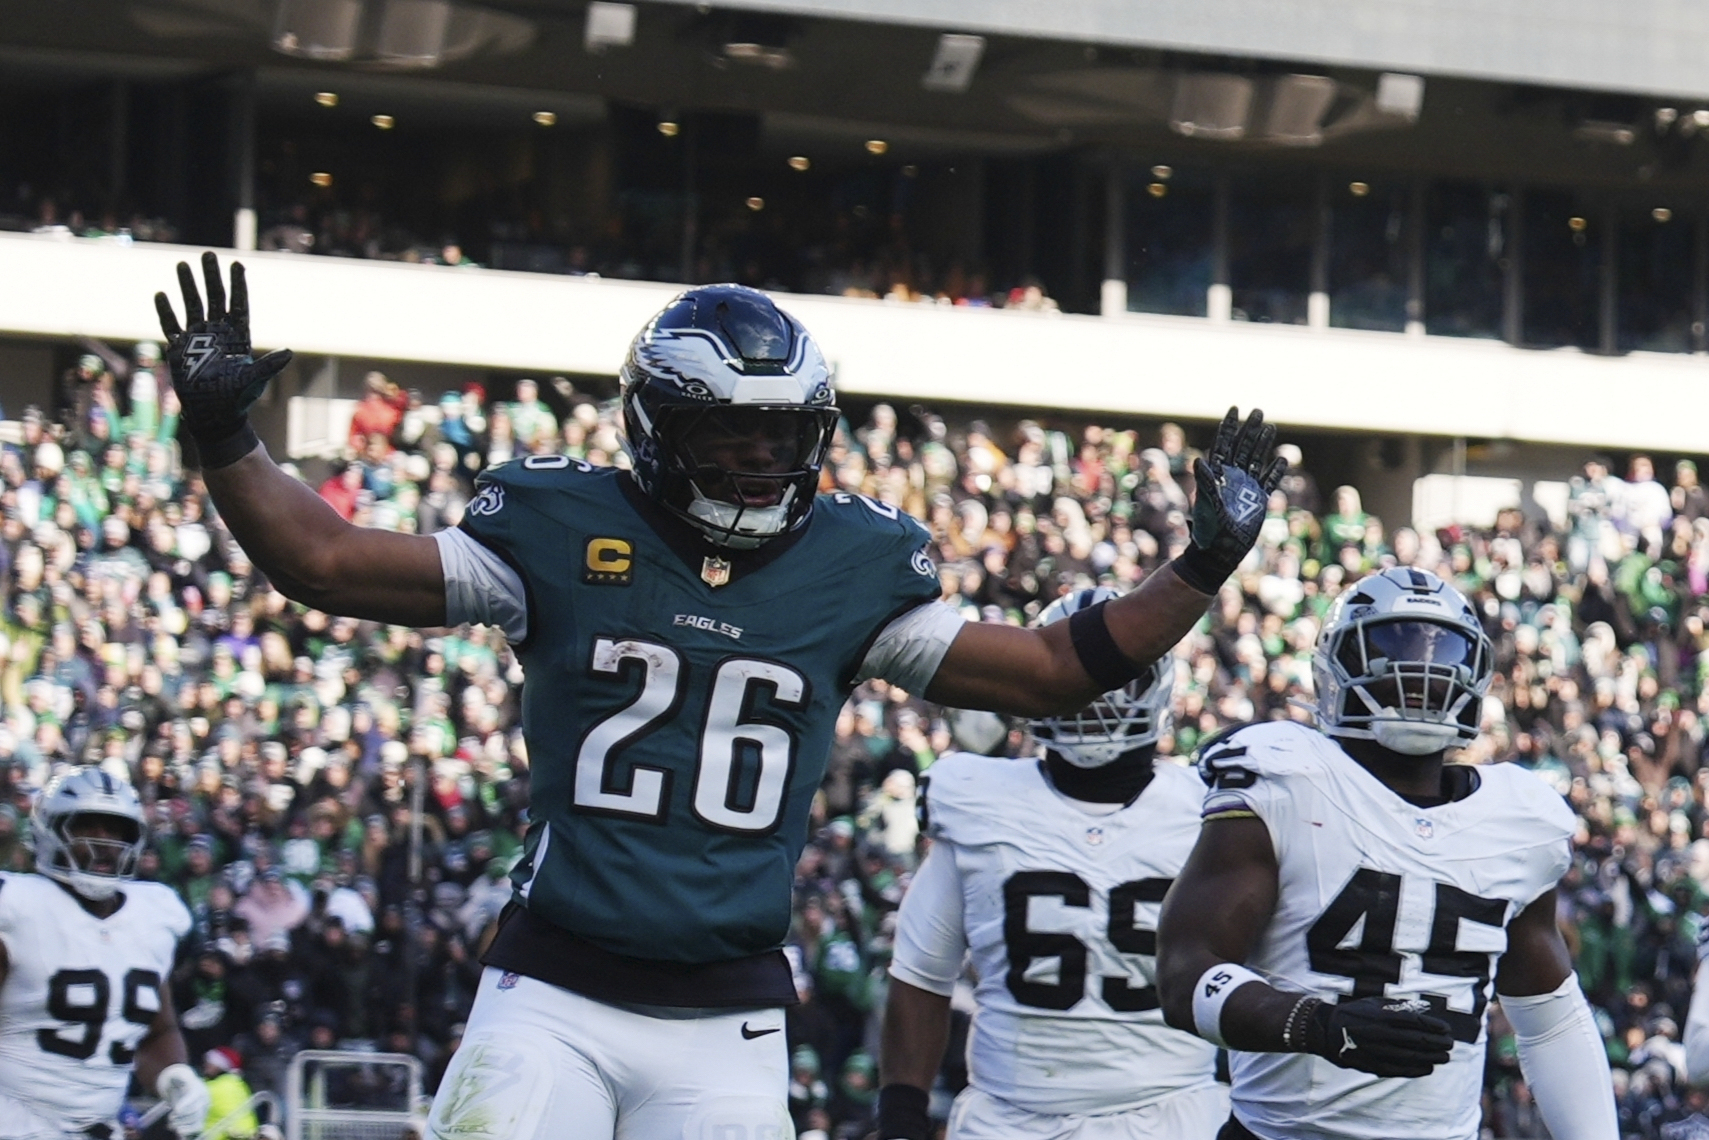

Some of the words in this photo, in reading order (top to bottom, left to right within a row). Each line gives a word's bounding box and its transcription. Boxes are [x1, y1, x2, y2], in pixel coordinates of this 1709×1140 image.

[586, 538, 631, 573] C
[673, 613, 744, 640] EAGLES
[573, 637, 805, 831] 26
[1306, 866, 1510, 1045] 45
[1205, 971, 1233, 998] 45
